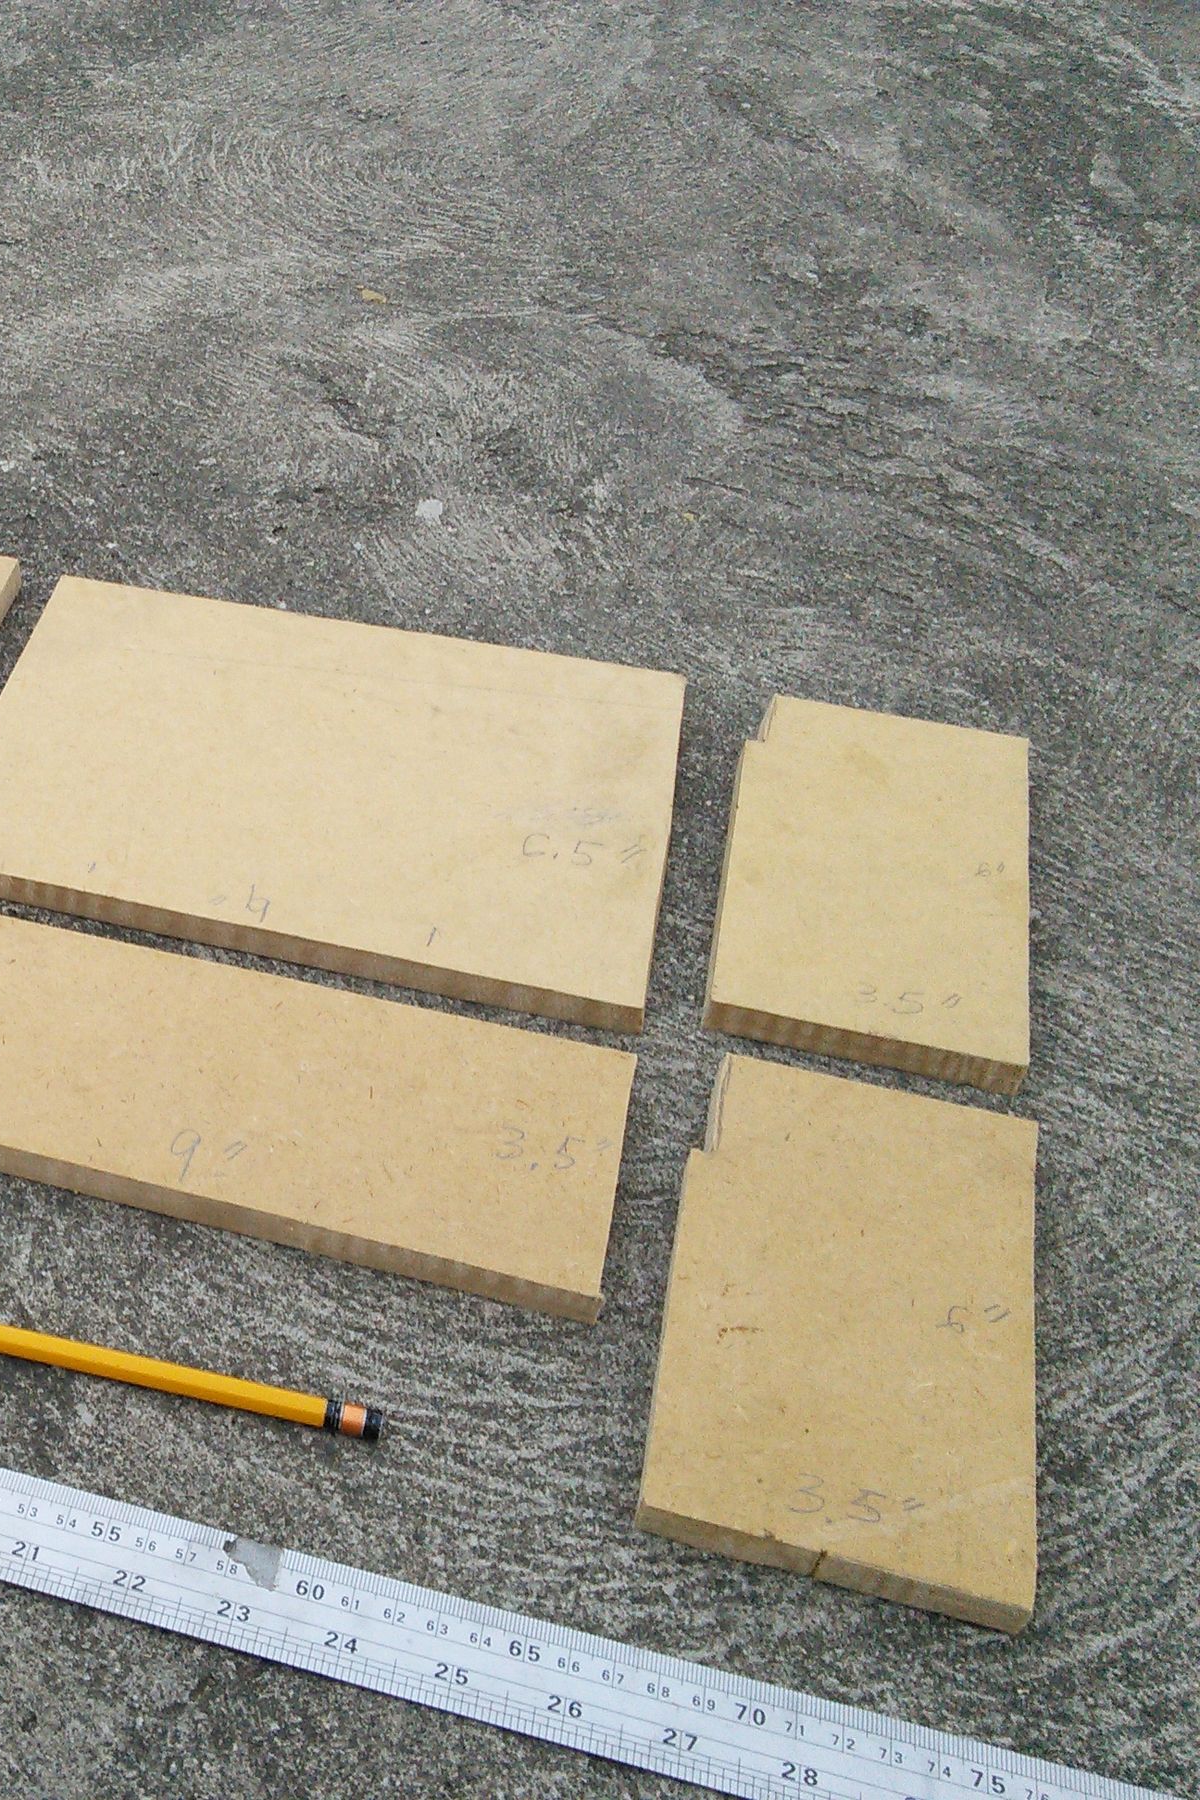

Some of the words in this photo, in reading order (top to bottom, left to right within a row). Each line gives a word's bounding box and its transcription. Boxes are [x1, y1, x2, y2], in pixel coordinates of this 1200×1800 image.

[11, 1540, 40, 1561] 21
[112, 1569, 147, 1593] 22
[216, 1600, 251, 1622] 23
[324, 1630, 358, 1655] 24
[434, 1662, 470, 1686] 25
[547, 1695, 583, 1718] 26
[663, 1728, 698, 1752] 27
[781, 1761, 819, 1787] 28
[17, 1503, 39, 1518] 53
[56, 1514, 77, 1529] 54
[91, 1521, 122, 1543] 55
[134, 1536, 157, 1552] 56
[175, 1548, 197, 1563] 57
[216, 1559, 238, 1575] 58
[295, 1580, 326, 1601] 60
[341, 1596, 361, 1610] 61
[383, 1607, 406, 1623] 62
[426, 1620, 449, 1636] 63
[469, 1632, 493, 1648] 64
[508, 1639, 541, 1663] 65
[557, 1657, 581, 1673] 66
[601, 1669, 625, 1685] 67
[646, 1682, 671, 1699] 68
[692, 1695, 716, 1711] 69
[735, 1702, 766, 1727] 70
[784, 1721, 805, 1736] 71
[831, 1734, 856, 1750] 72
[879, 1748, 903, 1764] 73
[927, 1760, 952, 1778] 74
[970, 1768, 1006, 1794] 75
